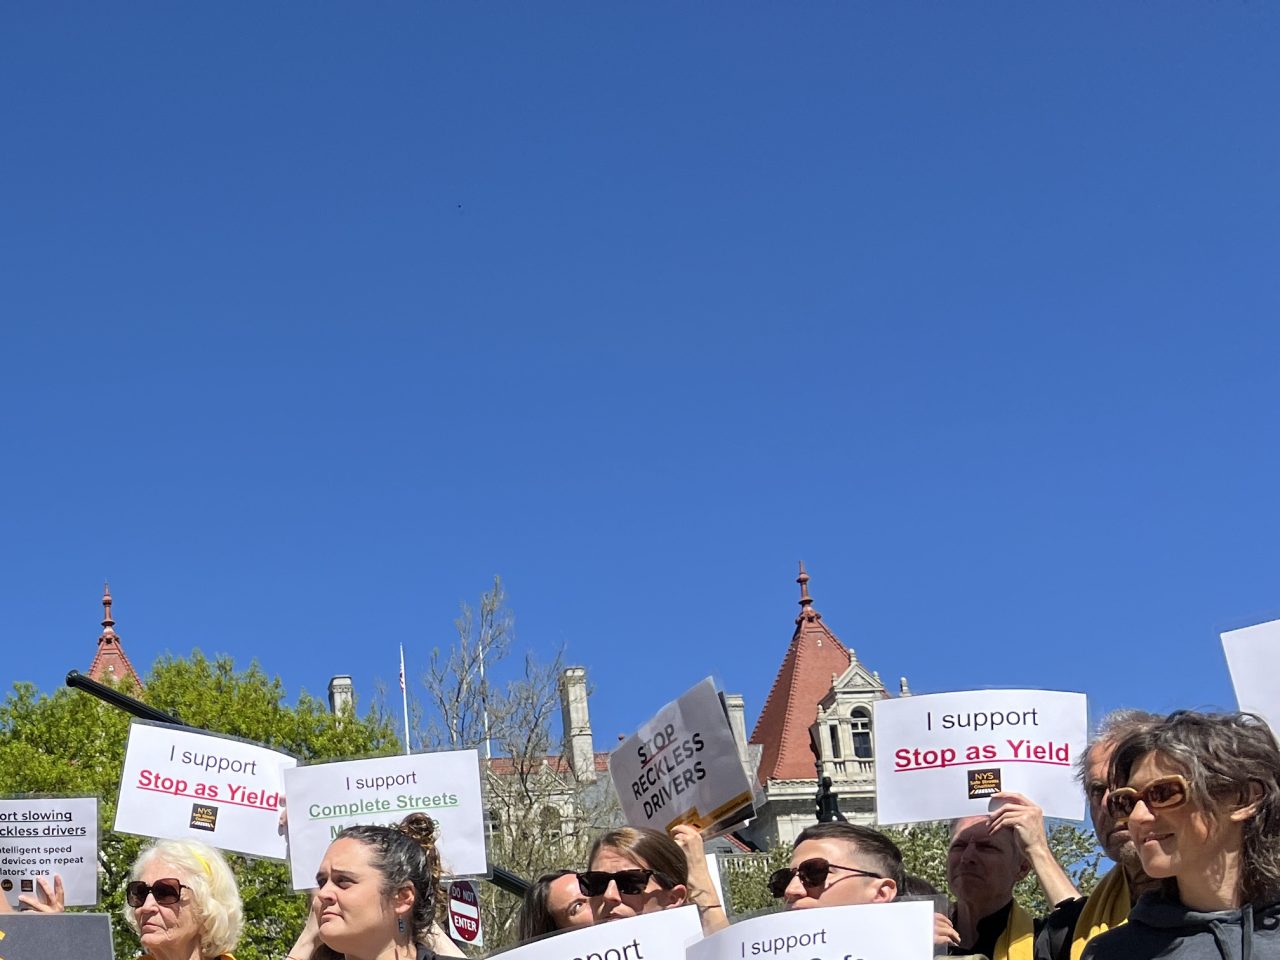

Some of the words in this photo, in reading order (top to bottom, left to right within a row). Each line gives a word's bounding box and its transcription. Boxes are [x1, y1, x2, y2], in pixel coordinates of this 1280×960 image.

[927, 712, 931, 731] I
[942, 708, 1039, 732] support
[637, 723, 676, 765] STOP
[895, 747, 956, 768] Stop
[966, 744, 997, 760] as
[1007, 739, 1070, 762] Yield
[170, 745, 175, 761] I
[181, 750, 257, 776] support
[631, 733, 705, 800] RECKLESS
[138, 769, 188, 796] Stop
[194, 782, 219, 798] as
[227, 783, 279, 808] Yield
[346, 776, 350, 790] I
[355, 771, 417, 791] support
[975, 772, 994, 780] NYS
[643, 761, 706, 820] DRIVERS
[22, 810, 72, 822] slowing
[309, 798, 391, 818] Complete
[396, 792, 458, 809] Streets
[42, 825, 87, 835] drivers
[1, 857, 37, 865] devices
[53, 856, 84, 866] repeat
[44, 845, 72, 855] speed
[454, 915, 477, 932] ENTER
[742, 942, 745, 958] I
[751, 929, 826, 955] support
